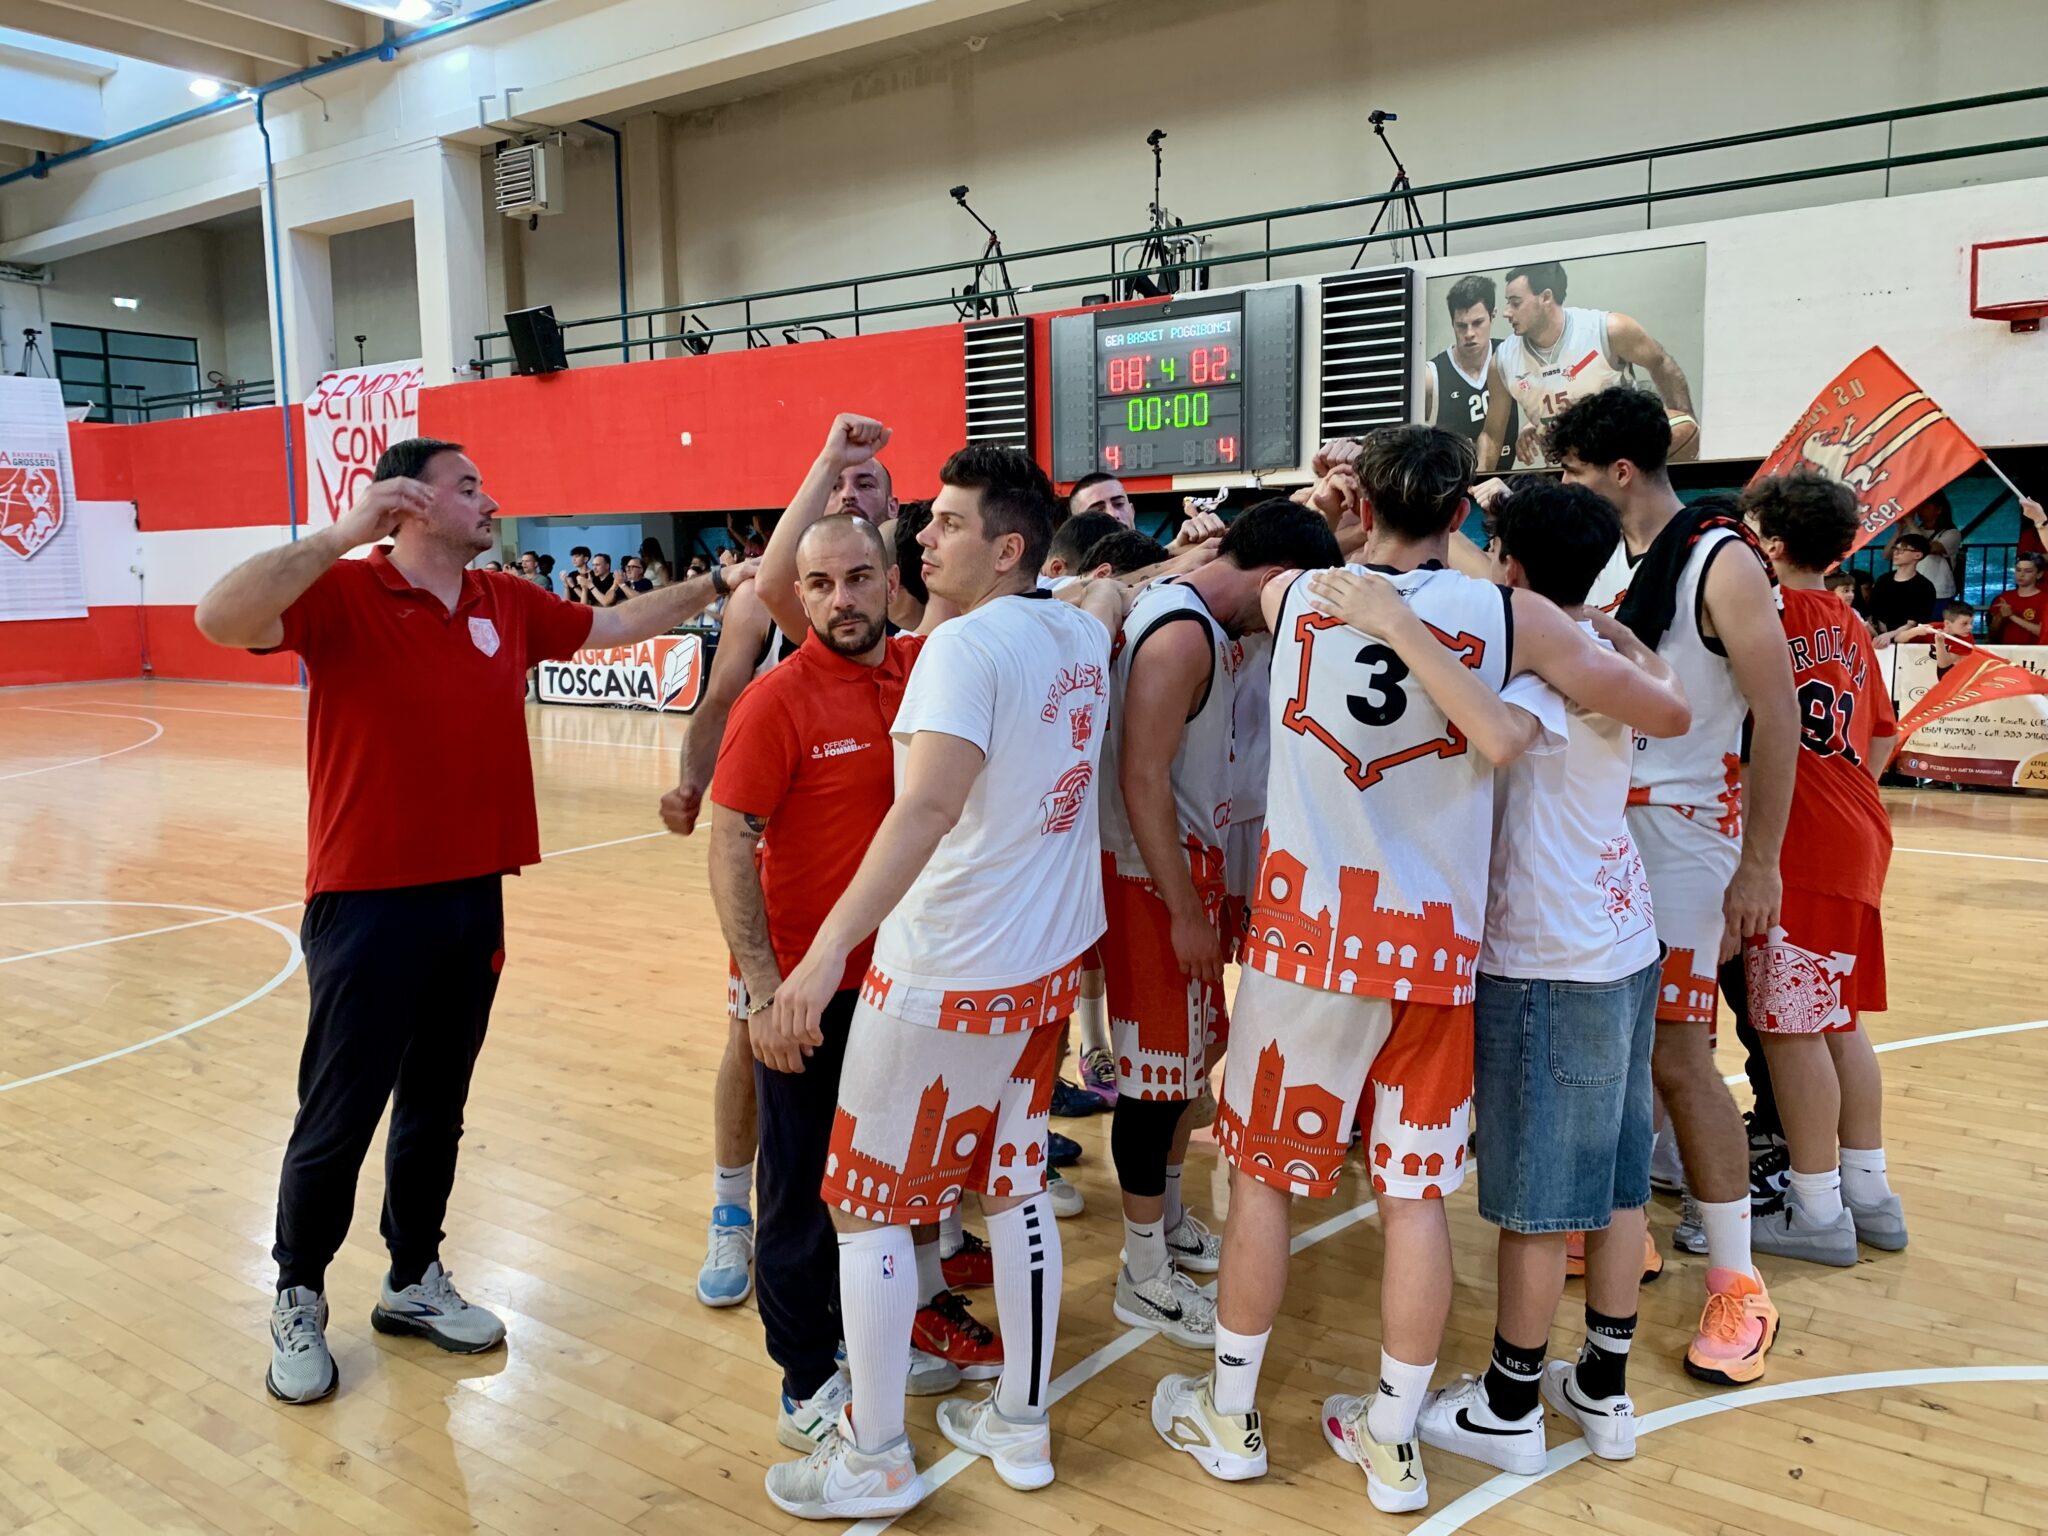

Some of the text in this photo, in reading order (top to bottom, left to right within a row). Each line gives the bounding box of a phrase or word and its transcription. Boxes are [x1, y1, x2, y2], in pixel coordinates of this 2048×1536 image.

[1105, 320, 1231, 347] GEA BASKET POGGIBONSI
[1160, 357, 1175, 382] 4
[1192, 345, 1227, 383] 82
[1542, 368, 1561, 377] mass
[308, 367, 423, 422] SEMPRE
[1128, 393, 1208, 432] 00:00
[333, 424, 388, 467] CON
[1105, 445, 1120, 470] 4
[1219, 437, 1234, 462] 4
[12, 458, 56, 466] GROSSETO
[544, 666, 656, 700] TOSCANA
[1346, 644, 1410, 727] 3
[1797, 679, 1861, 767] 91
[823, 737, 857, 751] OFFICINA
[1505, 1357, 1531, 1372] DES
